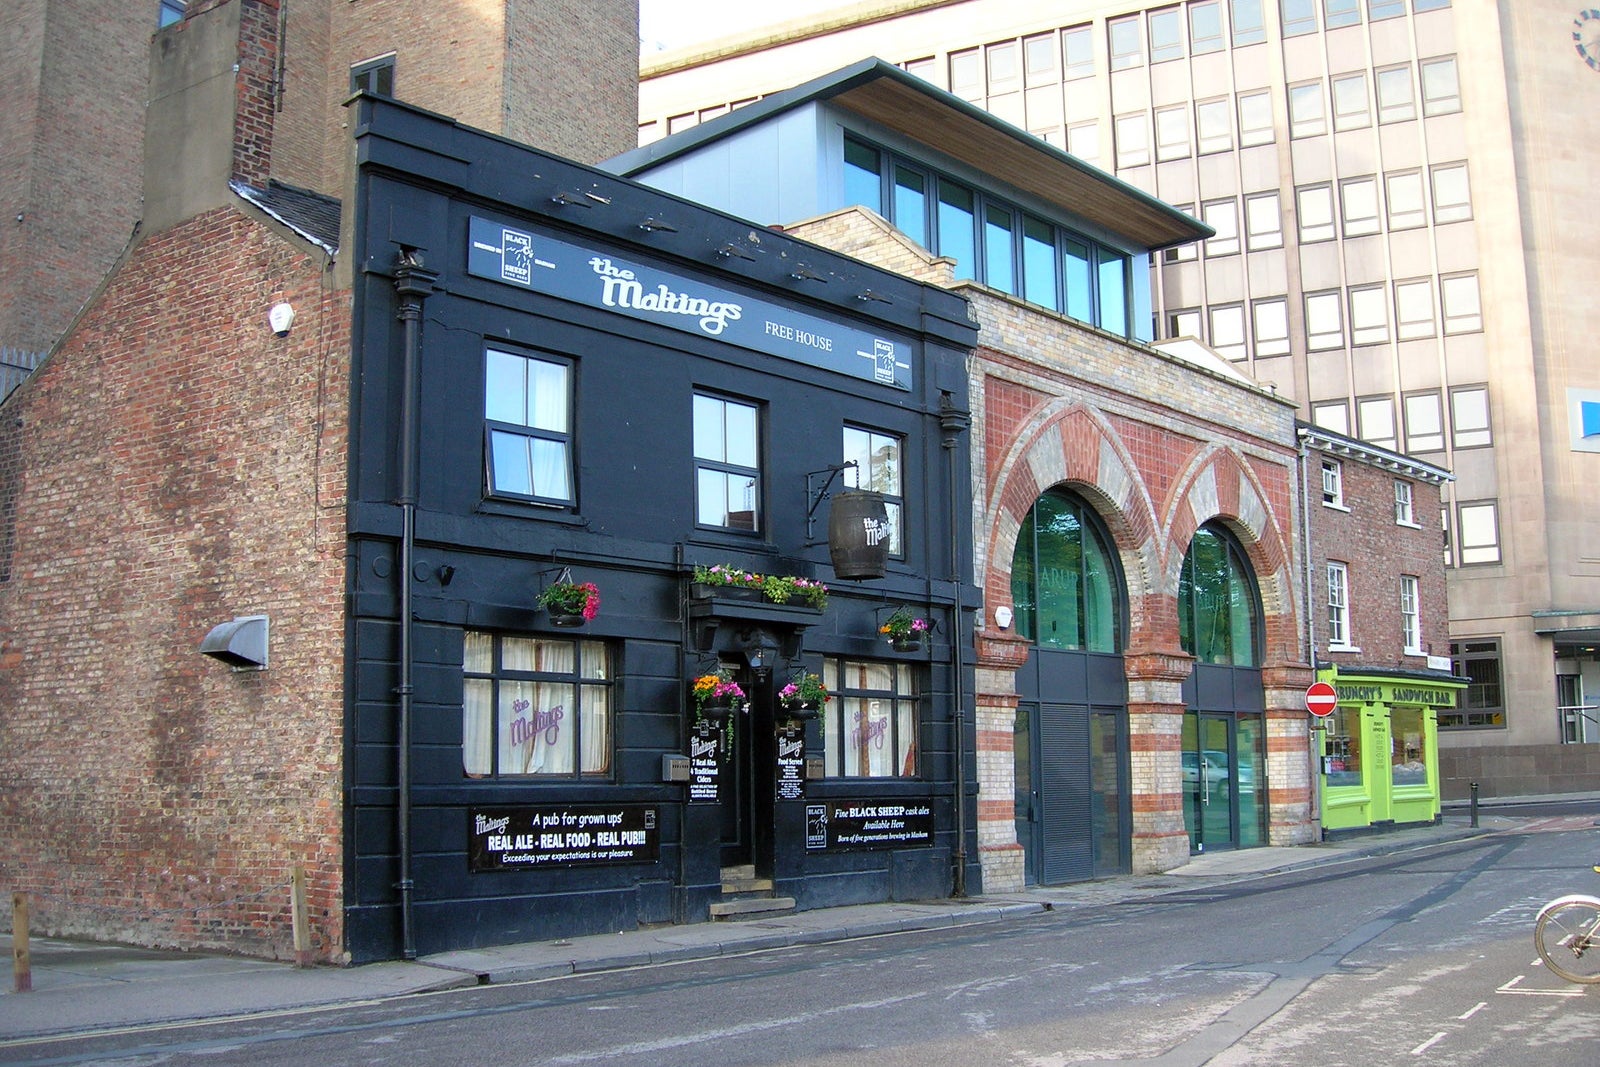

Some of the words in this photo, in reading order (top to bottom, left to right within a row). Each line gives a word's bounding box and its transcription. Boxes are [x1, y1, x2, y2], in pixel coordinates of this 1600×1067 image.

[505, 233, 528, 246] BLACK
[505, 264, 528, 276] SHEEP
[588, 257, 635, 280] the
[600, 275, 743, 335] Maltings
[765, 320, 794, 341] FREE
[795, 329, 833, 352] HOUSE
[863, 517, 879, 530] the
[1392, 687, 1434, 703] SANDWICH
[1435, 691, 1450, 704] BAR
[513, 699, 529, 713] the
[510, 705, 563, 747] Maltings
[696, 759, 706, 767] Real
[707, 759, 716, 767] Ales
[778, 758, 788, 766] Food
[789, 758, 803, 766] Served
[476, 813, 487, 821] the
[834, 808, 849, 818] Fine
[849, 806, 877, 818] BLACK
[878, 806, 905, 816] SHEEP
[905, 806, 918, 815] cask
[918, 805, 930, 815] ales
[476, 816, 510, 835] Maltings
[533, 813, 540, 826] A
[542, 812, 560, 829] pub
[562, 811, 577, 826] for
[579, 815, 606, 829] grown
[863, 819, 890, 830] Available
[890, 819, 905, 829] Here
[488, 835, 513, 851] REAL
[515, 834, 534, 850] ALE
[540, 833, 564, 849] REAL
[566, 832, 590, 848] FOOD
[597, 831, 620, 847] REAL
[621, 830, 646, 846] PUB!!!
[502, 853, 535, 864] Exceeding
[536, 854, 551, 863] your
[551, 851, 590, 862] expectations
[591, 850, 597, 858] is
[609, 849, 634, 860] pleasure
